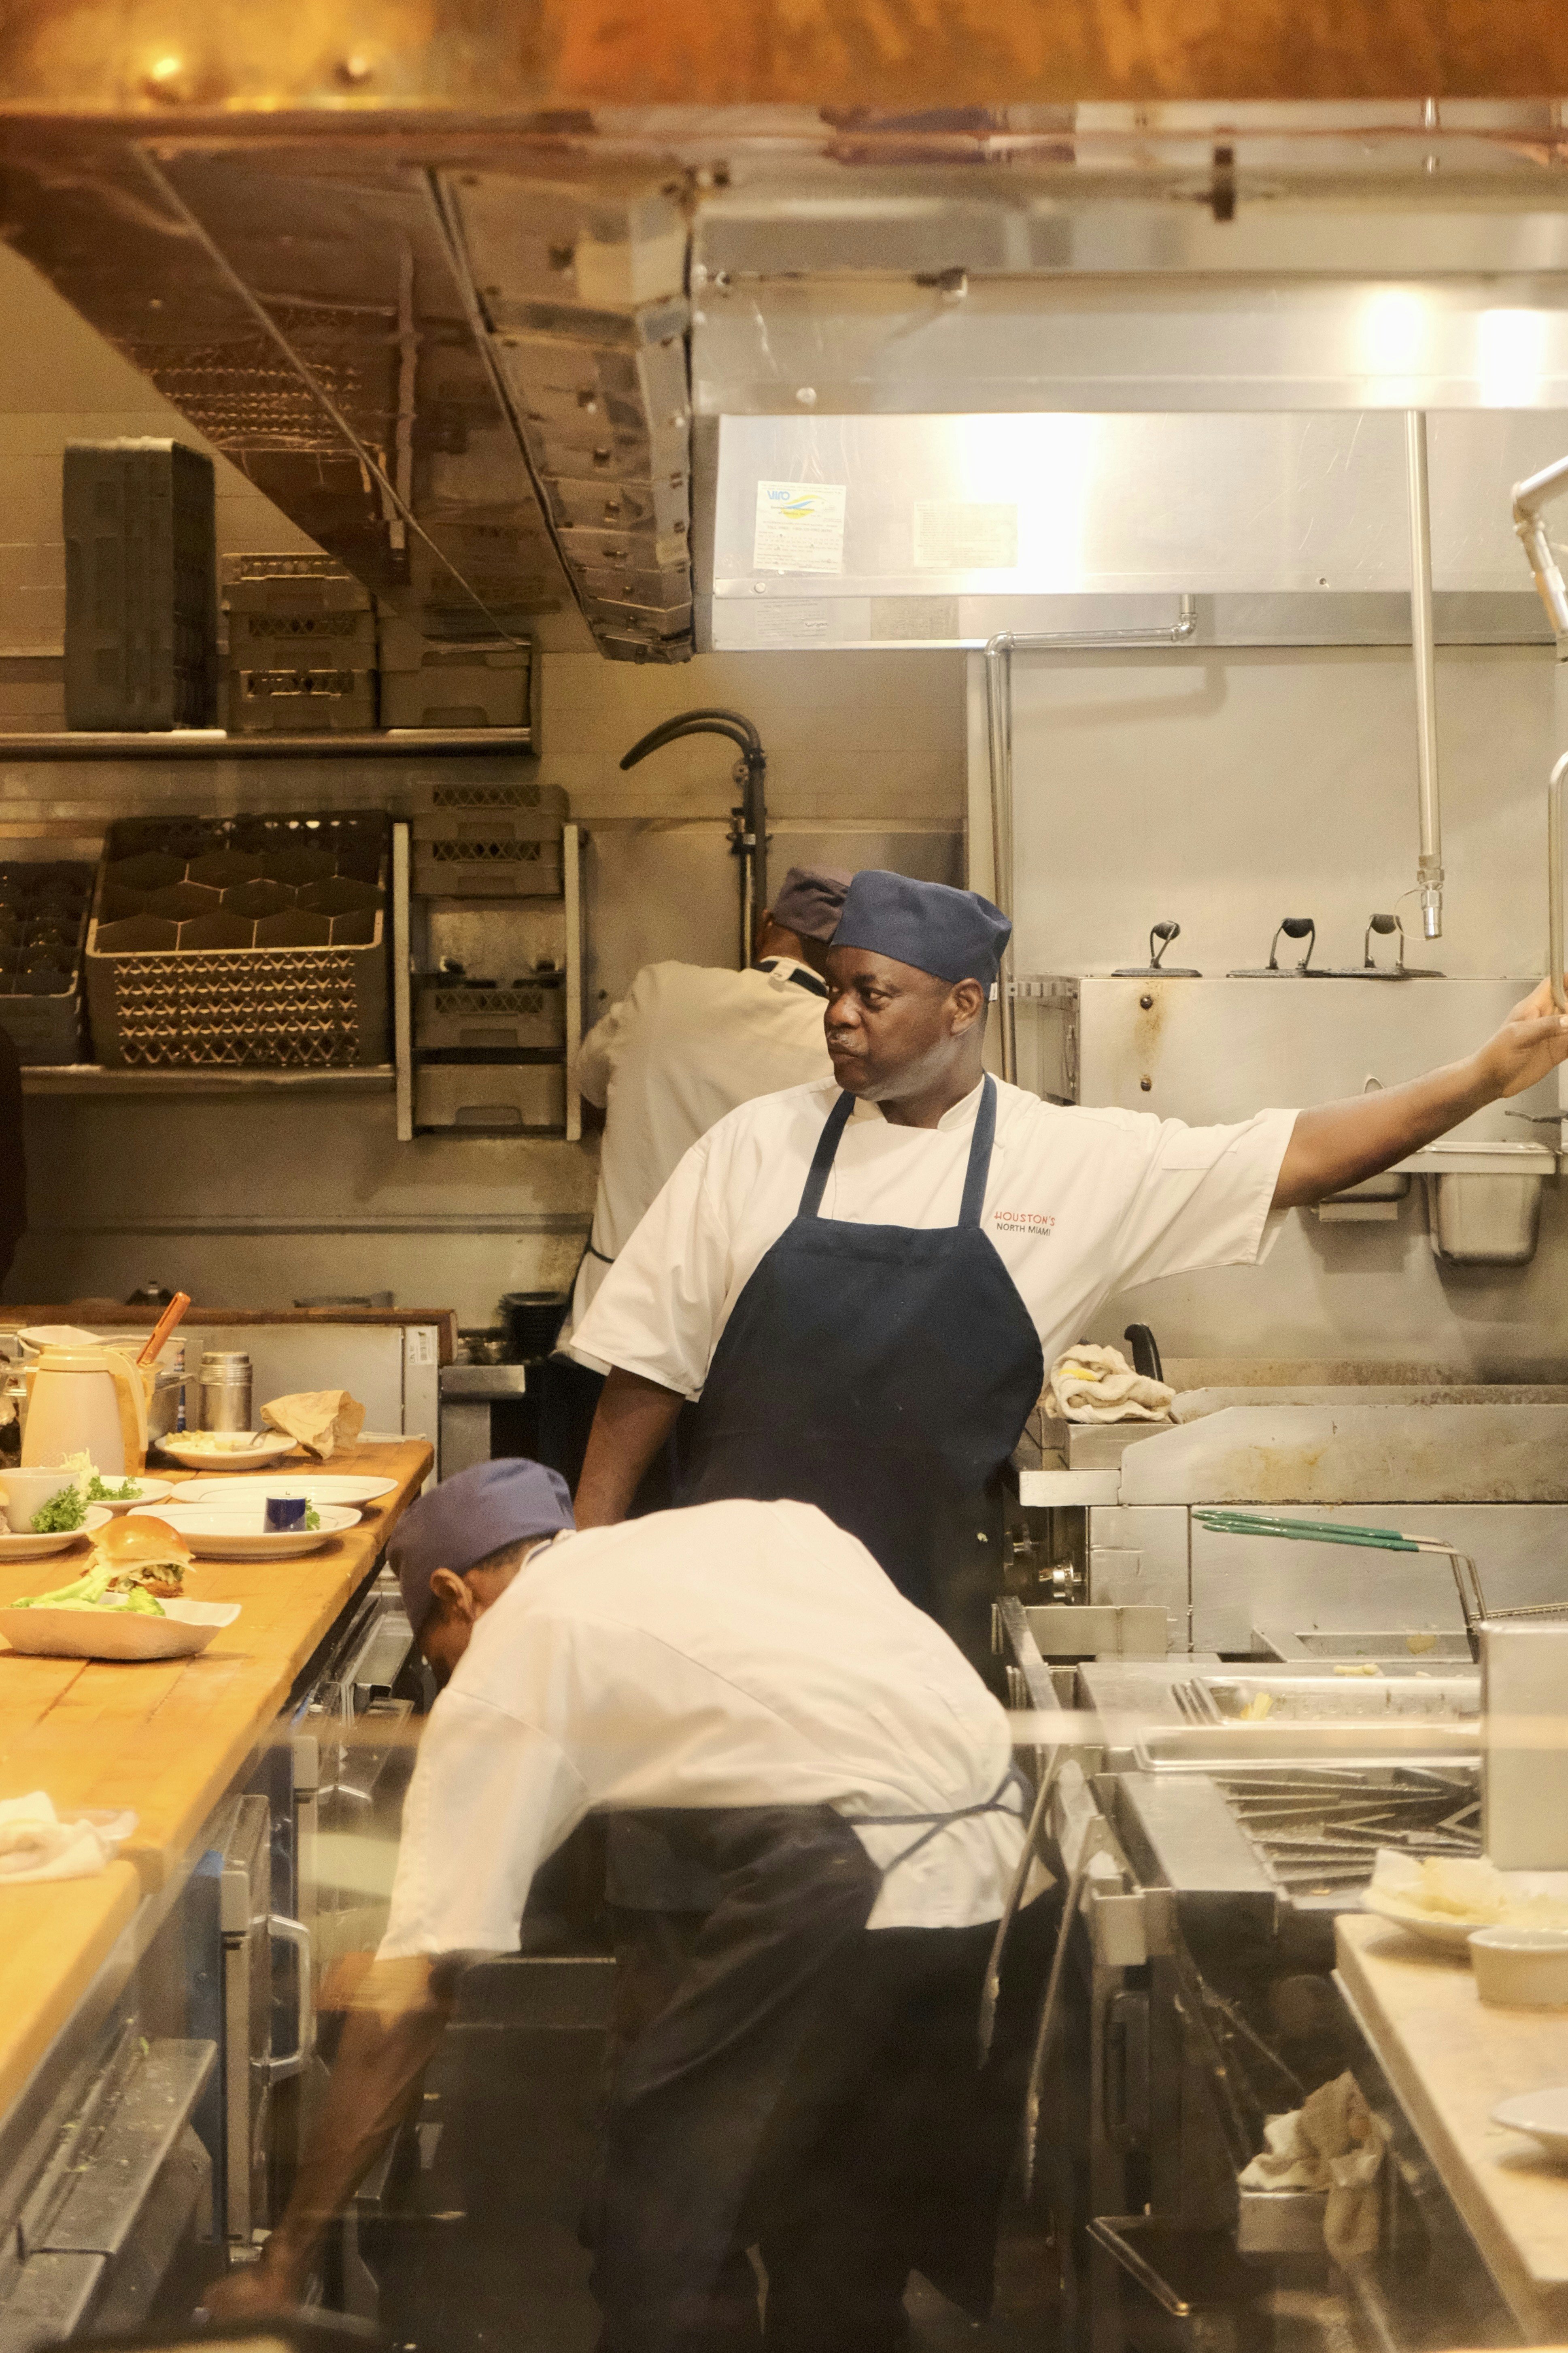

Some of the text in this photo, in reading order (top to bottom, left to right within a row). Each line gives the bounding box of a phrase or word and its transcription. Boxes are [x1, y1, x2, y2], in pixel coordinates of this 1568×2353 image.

[994, 1211, 1056, 1226] HOUSTON'S
[996, 1223, 1051, 1236] NORTH MIAMI
